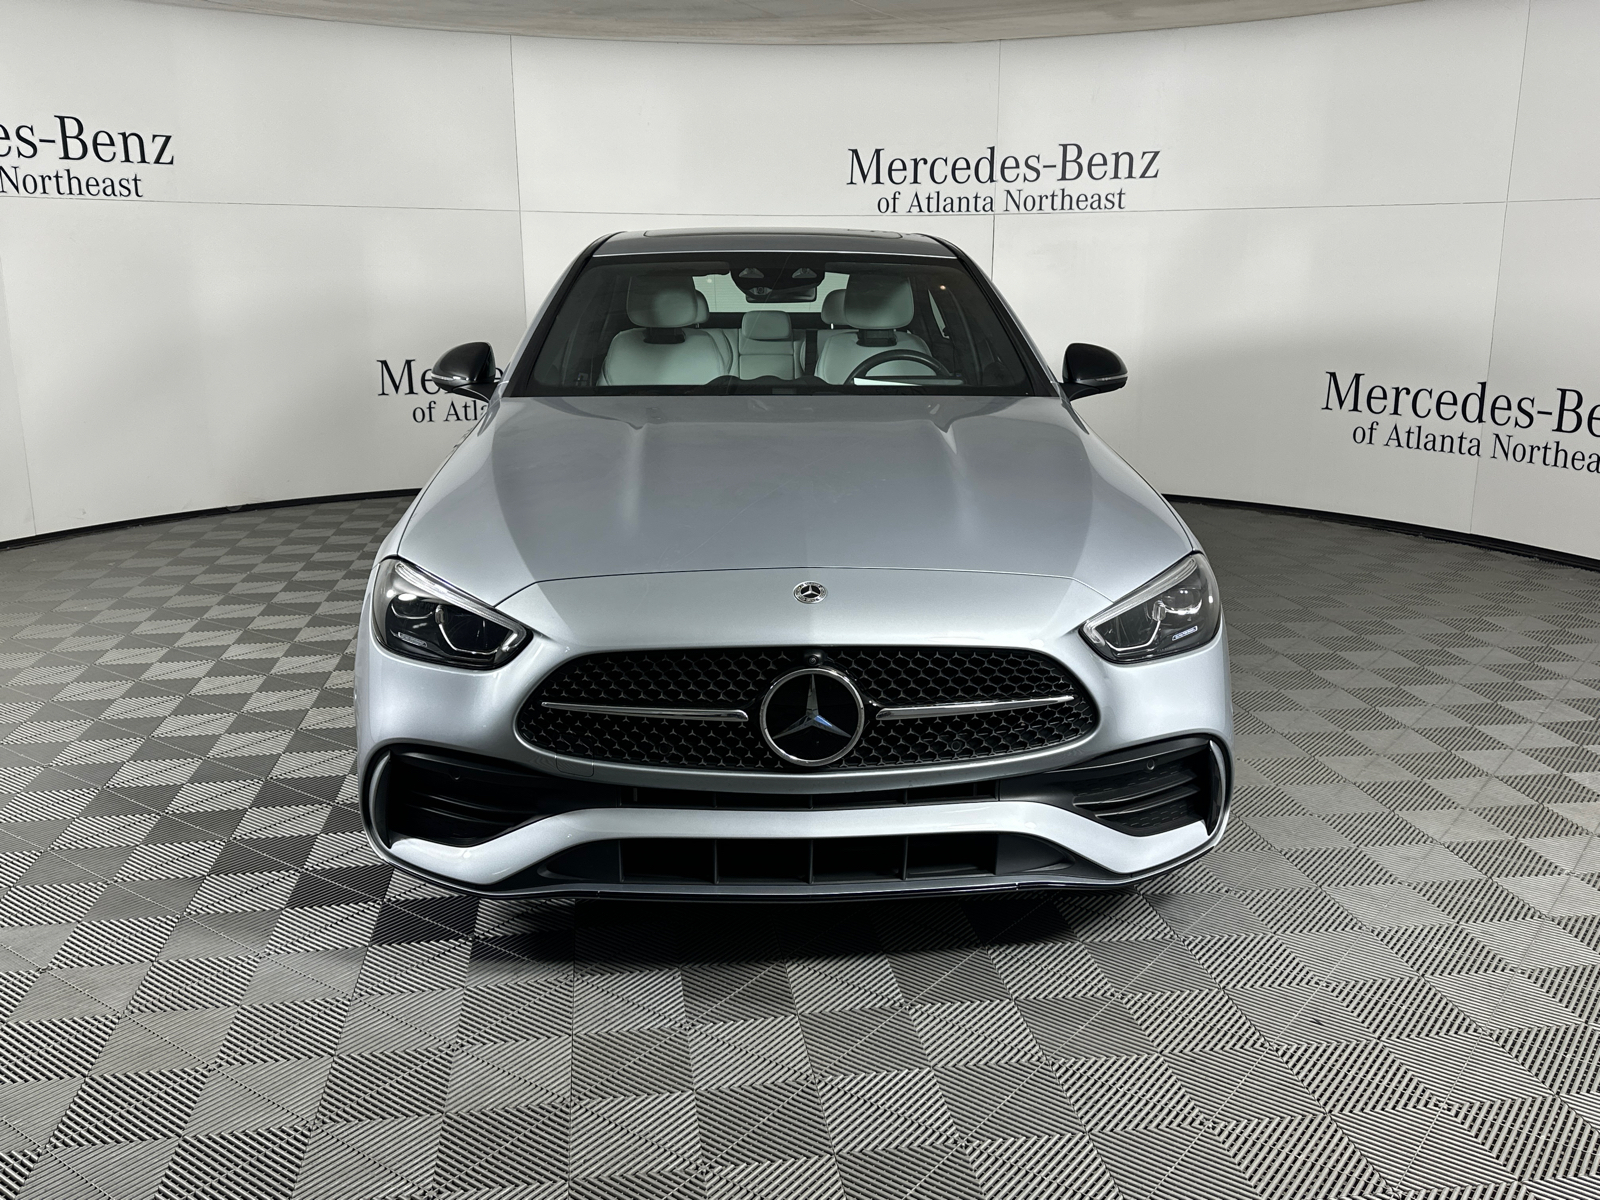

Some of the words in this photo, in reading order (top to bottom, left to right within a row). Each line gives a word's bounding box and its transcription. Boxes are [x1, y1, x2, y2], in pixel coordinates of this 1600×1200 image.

[847, 143, 1161, 185] Mercedes-Benz
[0, 166, 143, 198] Northeast
[877, 191, 900, 213] of
[907, 191, 995, 213] Atlanta
[1004, 188, 1126, 212] Northeast
[412, 400, 436, 423] of
[1352, 421, 1379, 444] of
[1384, 423, 1481, 457] Atlanta
[1490, 432, 1600, 474] Northea
